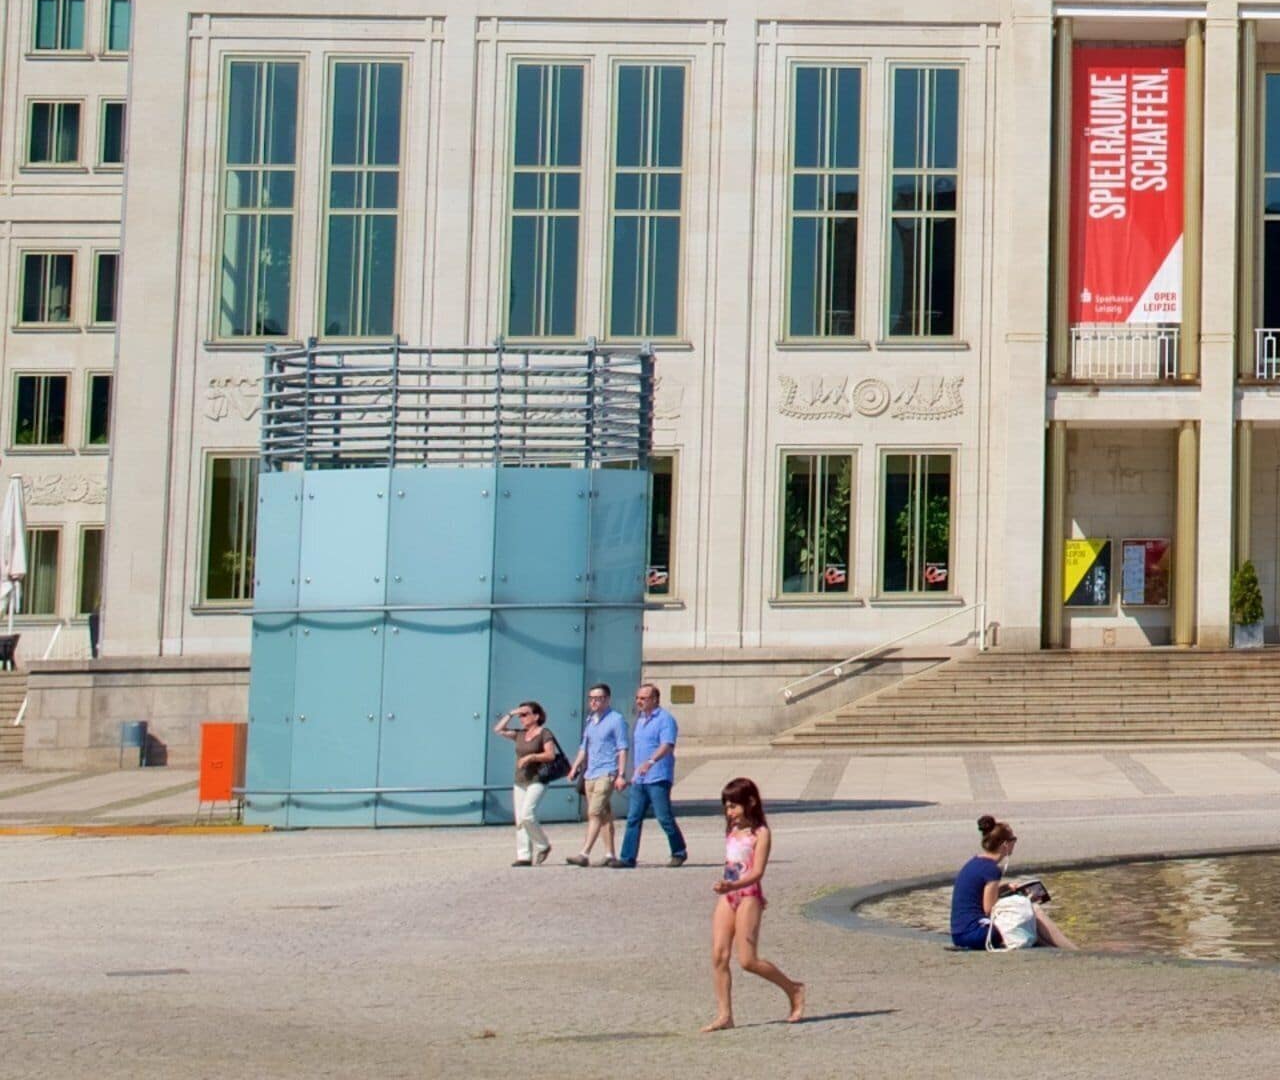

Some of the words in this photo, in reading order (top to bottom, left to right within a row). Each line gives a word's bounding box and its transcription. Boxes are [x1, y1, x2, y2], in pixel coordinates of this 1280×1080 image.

[1084, 73, 1127, 219] SPIELRÄUME
[1131, 68, 1169, 192] SCHAFFEN.
[1143, 303, 1177, 312] LEIPZIG
[1153, 292, 1177, 301] OPER
